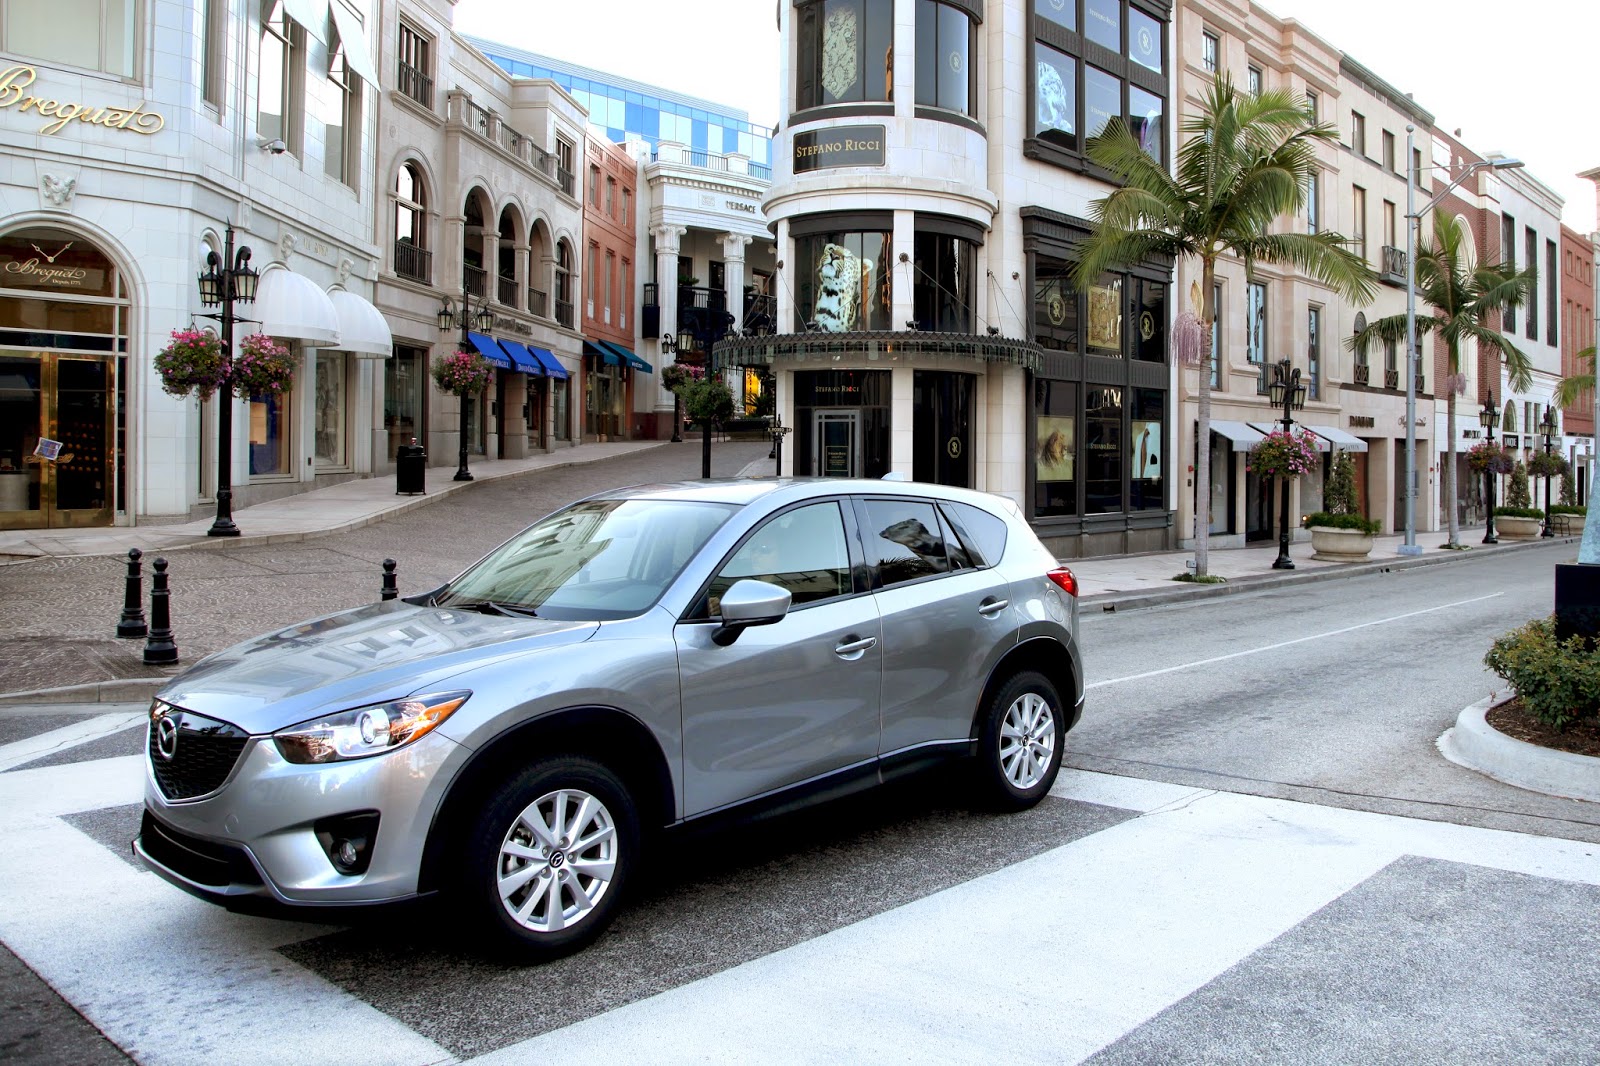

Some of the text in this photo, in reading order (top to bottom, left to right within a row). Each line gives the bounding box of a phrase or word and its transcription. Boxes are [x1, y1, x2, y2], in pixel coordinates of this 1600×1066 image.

[0, 65, 165, 135] Breguet
[796, 139, 880, 158] STEFANO RICCI
[726, 200, 757, 214] VERSACE
[5, 257, 87, 283] Breguet
